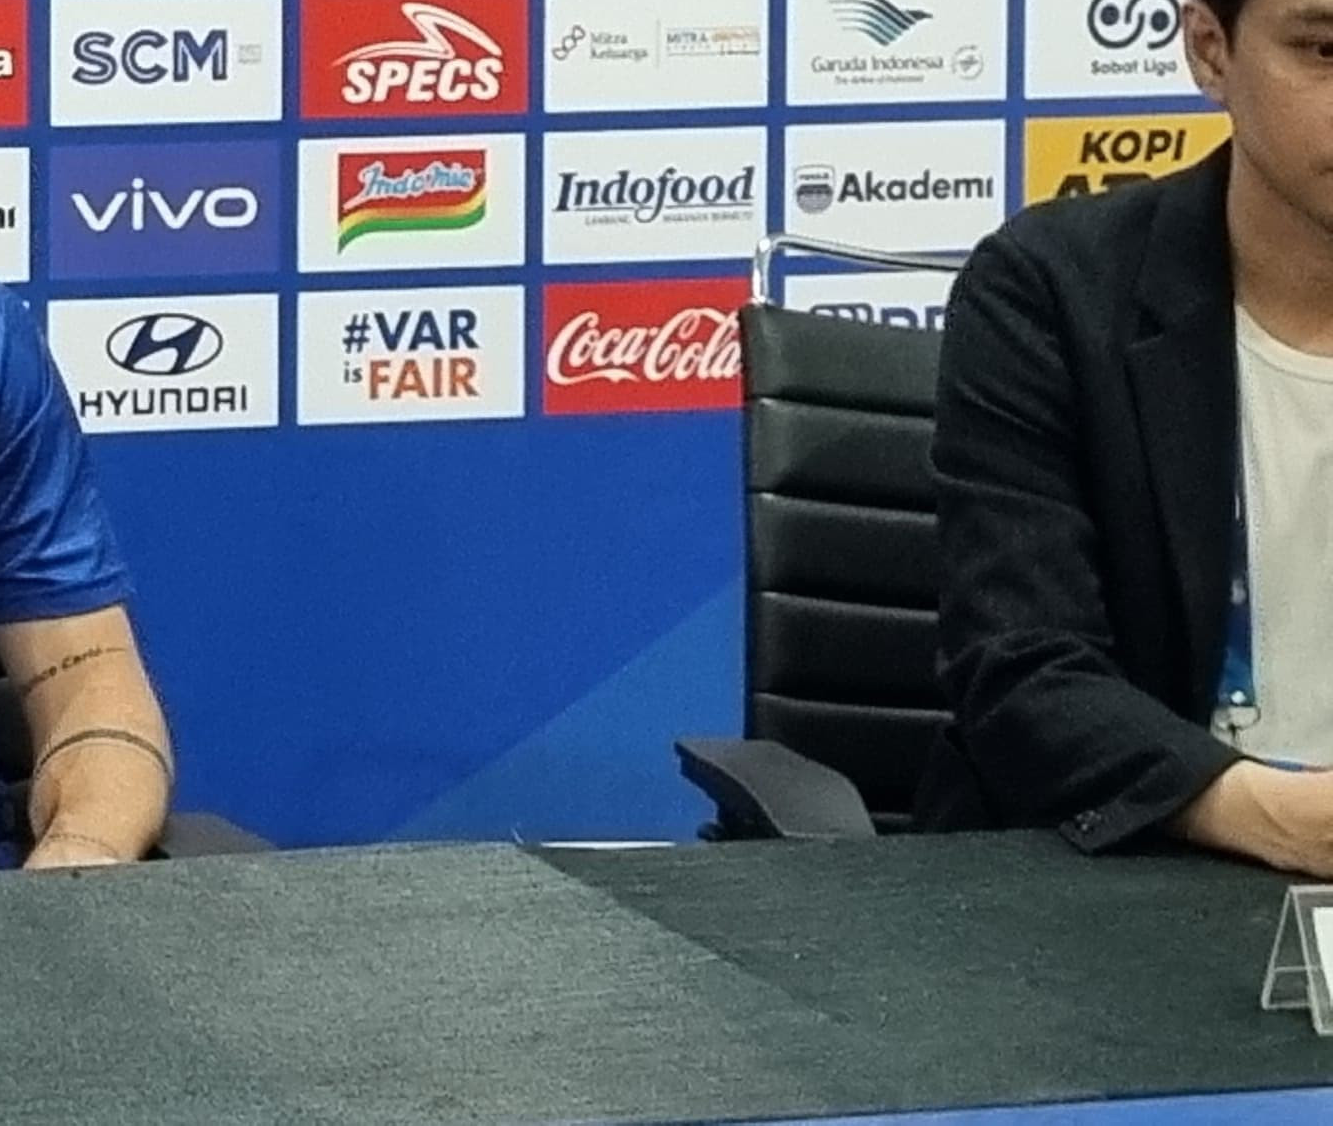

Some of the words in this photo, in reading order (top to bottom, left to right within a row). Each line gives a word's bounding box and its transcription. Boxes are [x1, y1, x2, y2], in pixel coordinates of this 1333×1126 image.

[73, 30, 228, 84] SCM
[342, 58, 502, 104] SPECS
[1079, 129, 1186, 163] KOPI
[71, 178, 258, 231] vivo
[552, 166, 755, 222] Indofood
[837, 170, 993, 203] Akademi
[343, 310, 478, 351] #VAR
[547, 308, 742, 385] Coca-Cola
[344, 363, 363, 383] is
[369, 358, 478, 399] FAIR
[80, 386, 247, 415] HYUNDAI
